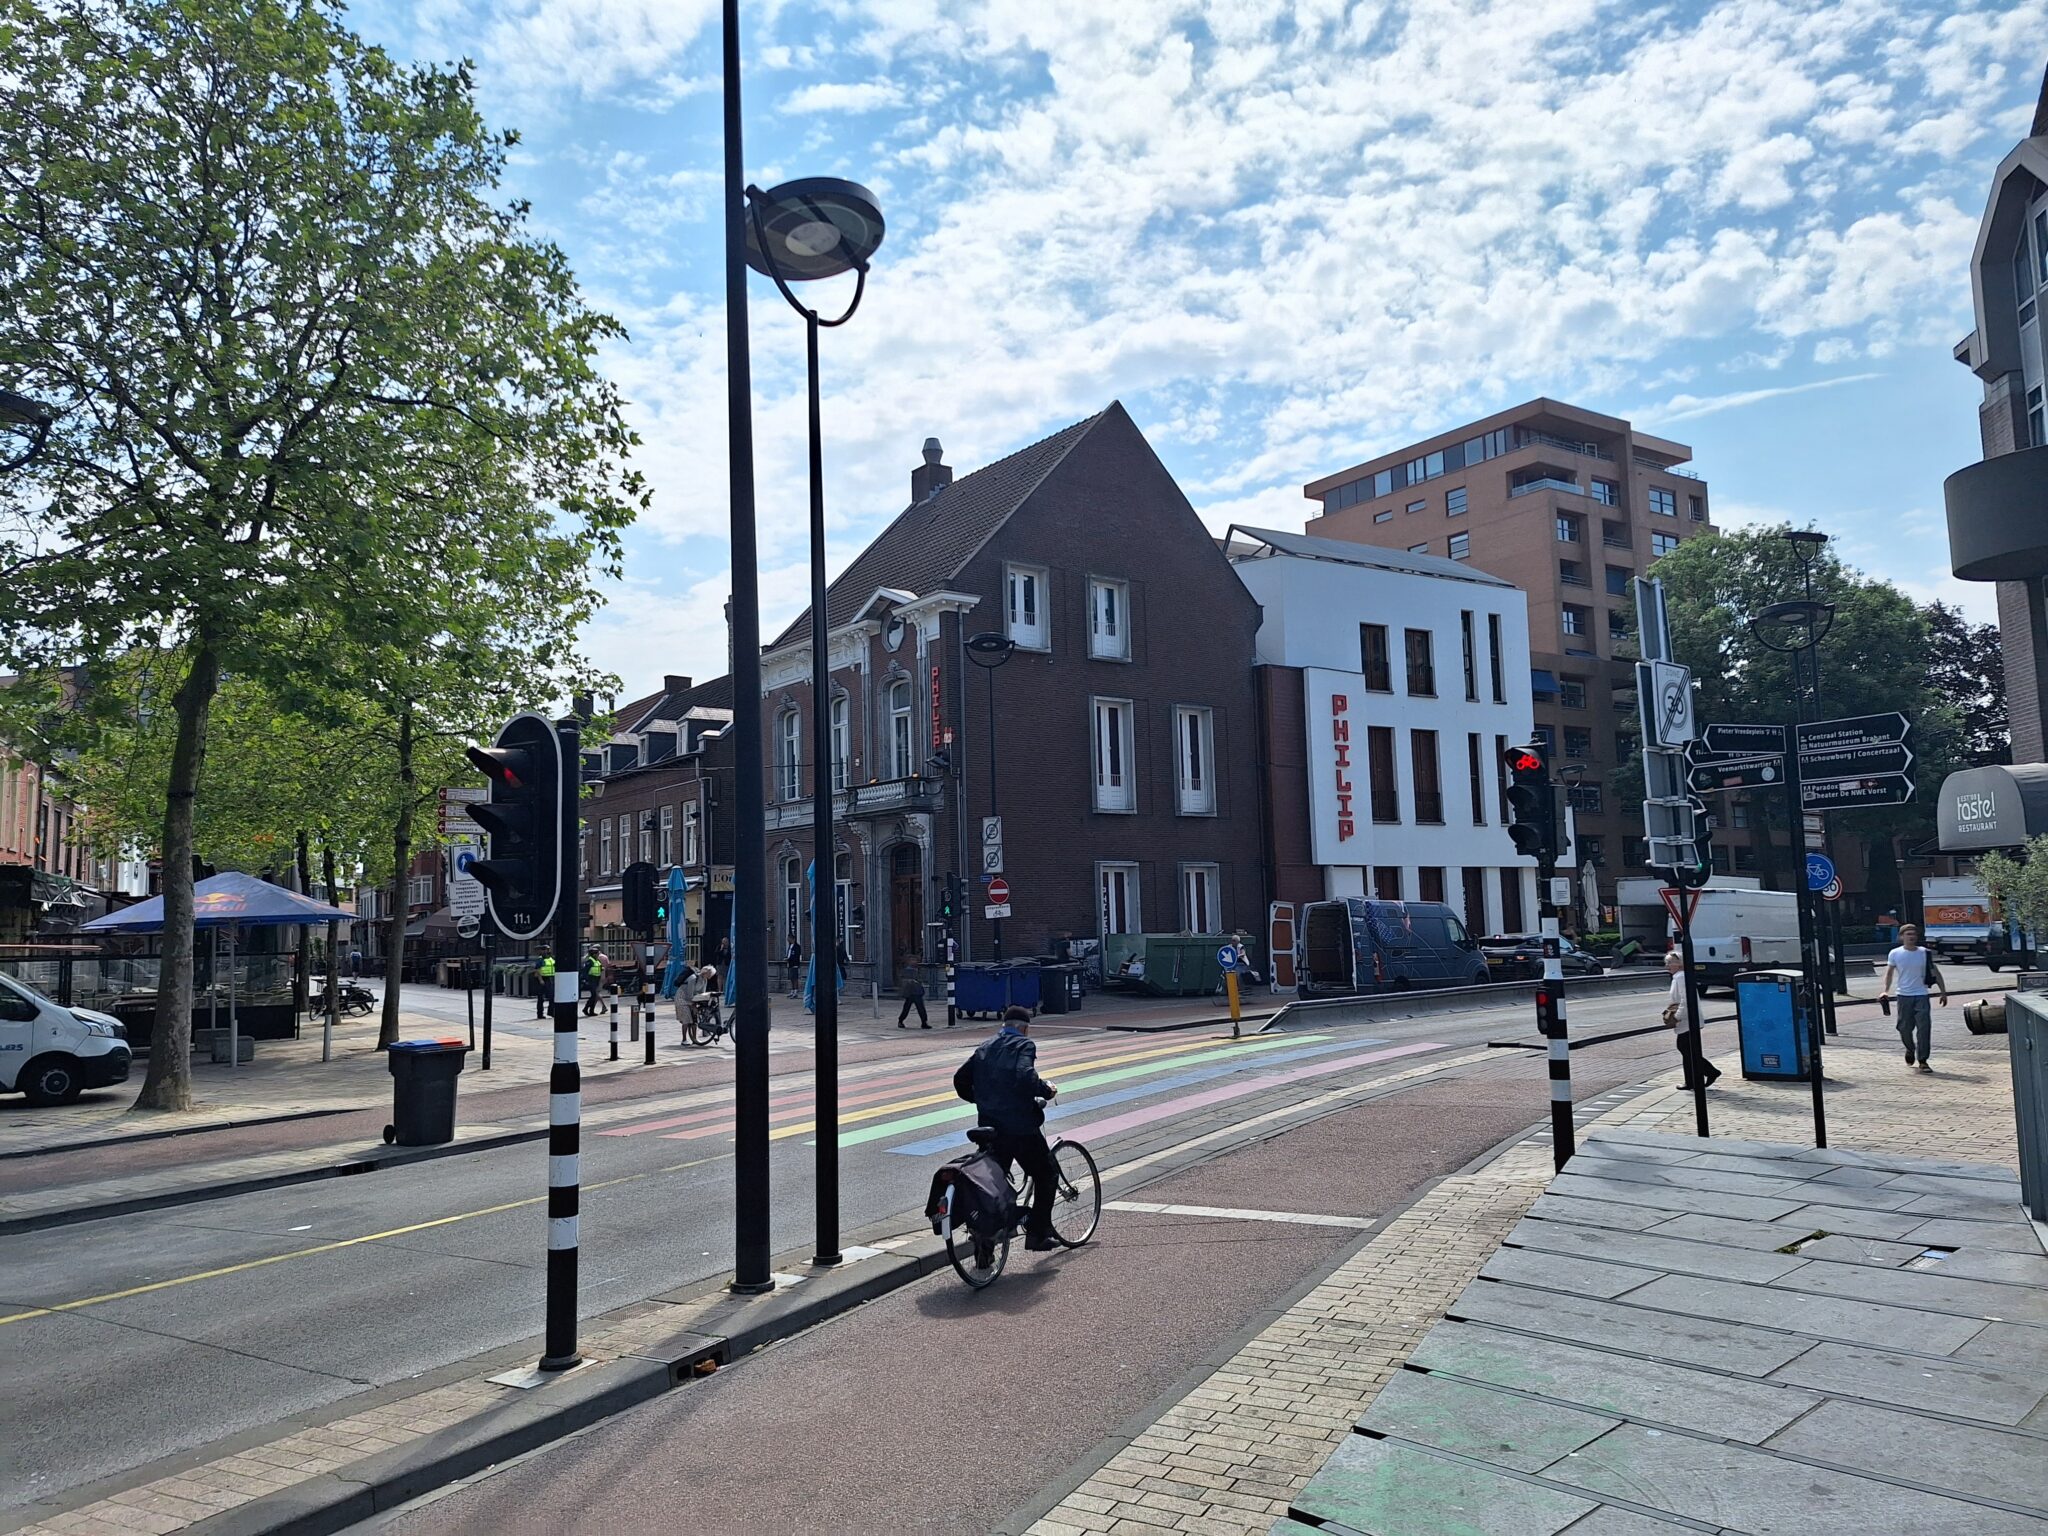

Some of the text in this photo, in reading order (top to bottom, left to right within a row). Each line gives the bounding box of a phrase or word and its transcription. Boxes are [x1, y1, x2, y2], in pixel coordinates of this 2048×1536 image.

[931, 666, 940, 748] PHILIP
[1667, 695, 1684, 715] 30
[1808, 729, 1864, 741] Centraal Station
[1808, 734, 1890, 749] Natuurmuseum Brabant
[1810, 752, 1852, 763] Schouwburg
[1857, 747, 1900, 757] Concertzaal
[1332, 694, 1354, 843] PHILIP
[1812, 784, 1838, 792] Paradox
[1867, 787, 1887, 795] Vorst
[1957, 791, 1996, 821] taste!
[1958, 821, 1998, 833] RESTAURANT
[513, 913, 530, 924] 11.1
